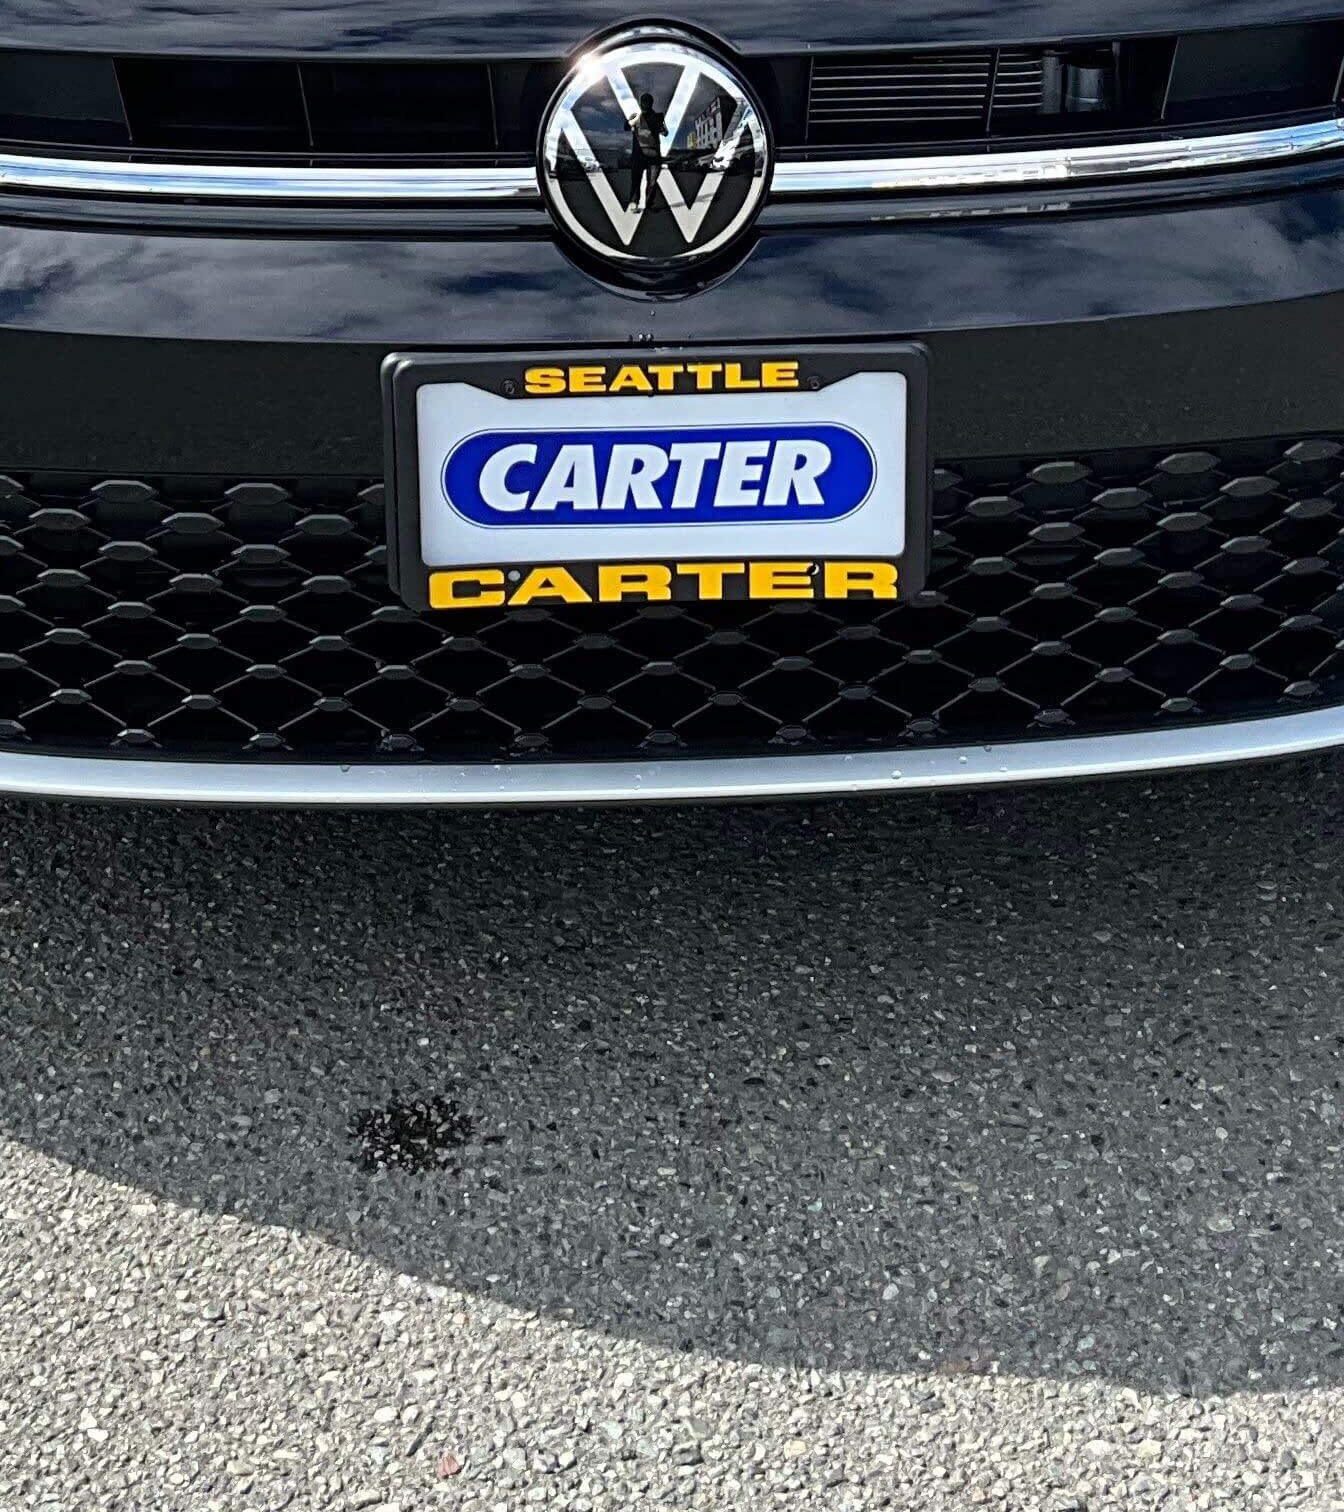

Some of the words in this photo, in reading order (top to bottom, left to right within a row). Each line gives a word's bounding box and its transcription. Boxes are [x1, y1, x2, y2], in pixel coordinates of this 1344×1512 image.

[548, 47, 765, 254] VW
[524, 361, 799, 394] SEATTLE
[478, 439, 833, 513] CARTER
[428, 561, 898, 609] CARTER
